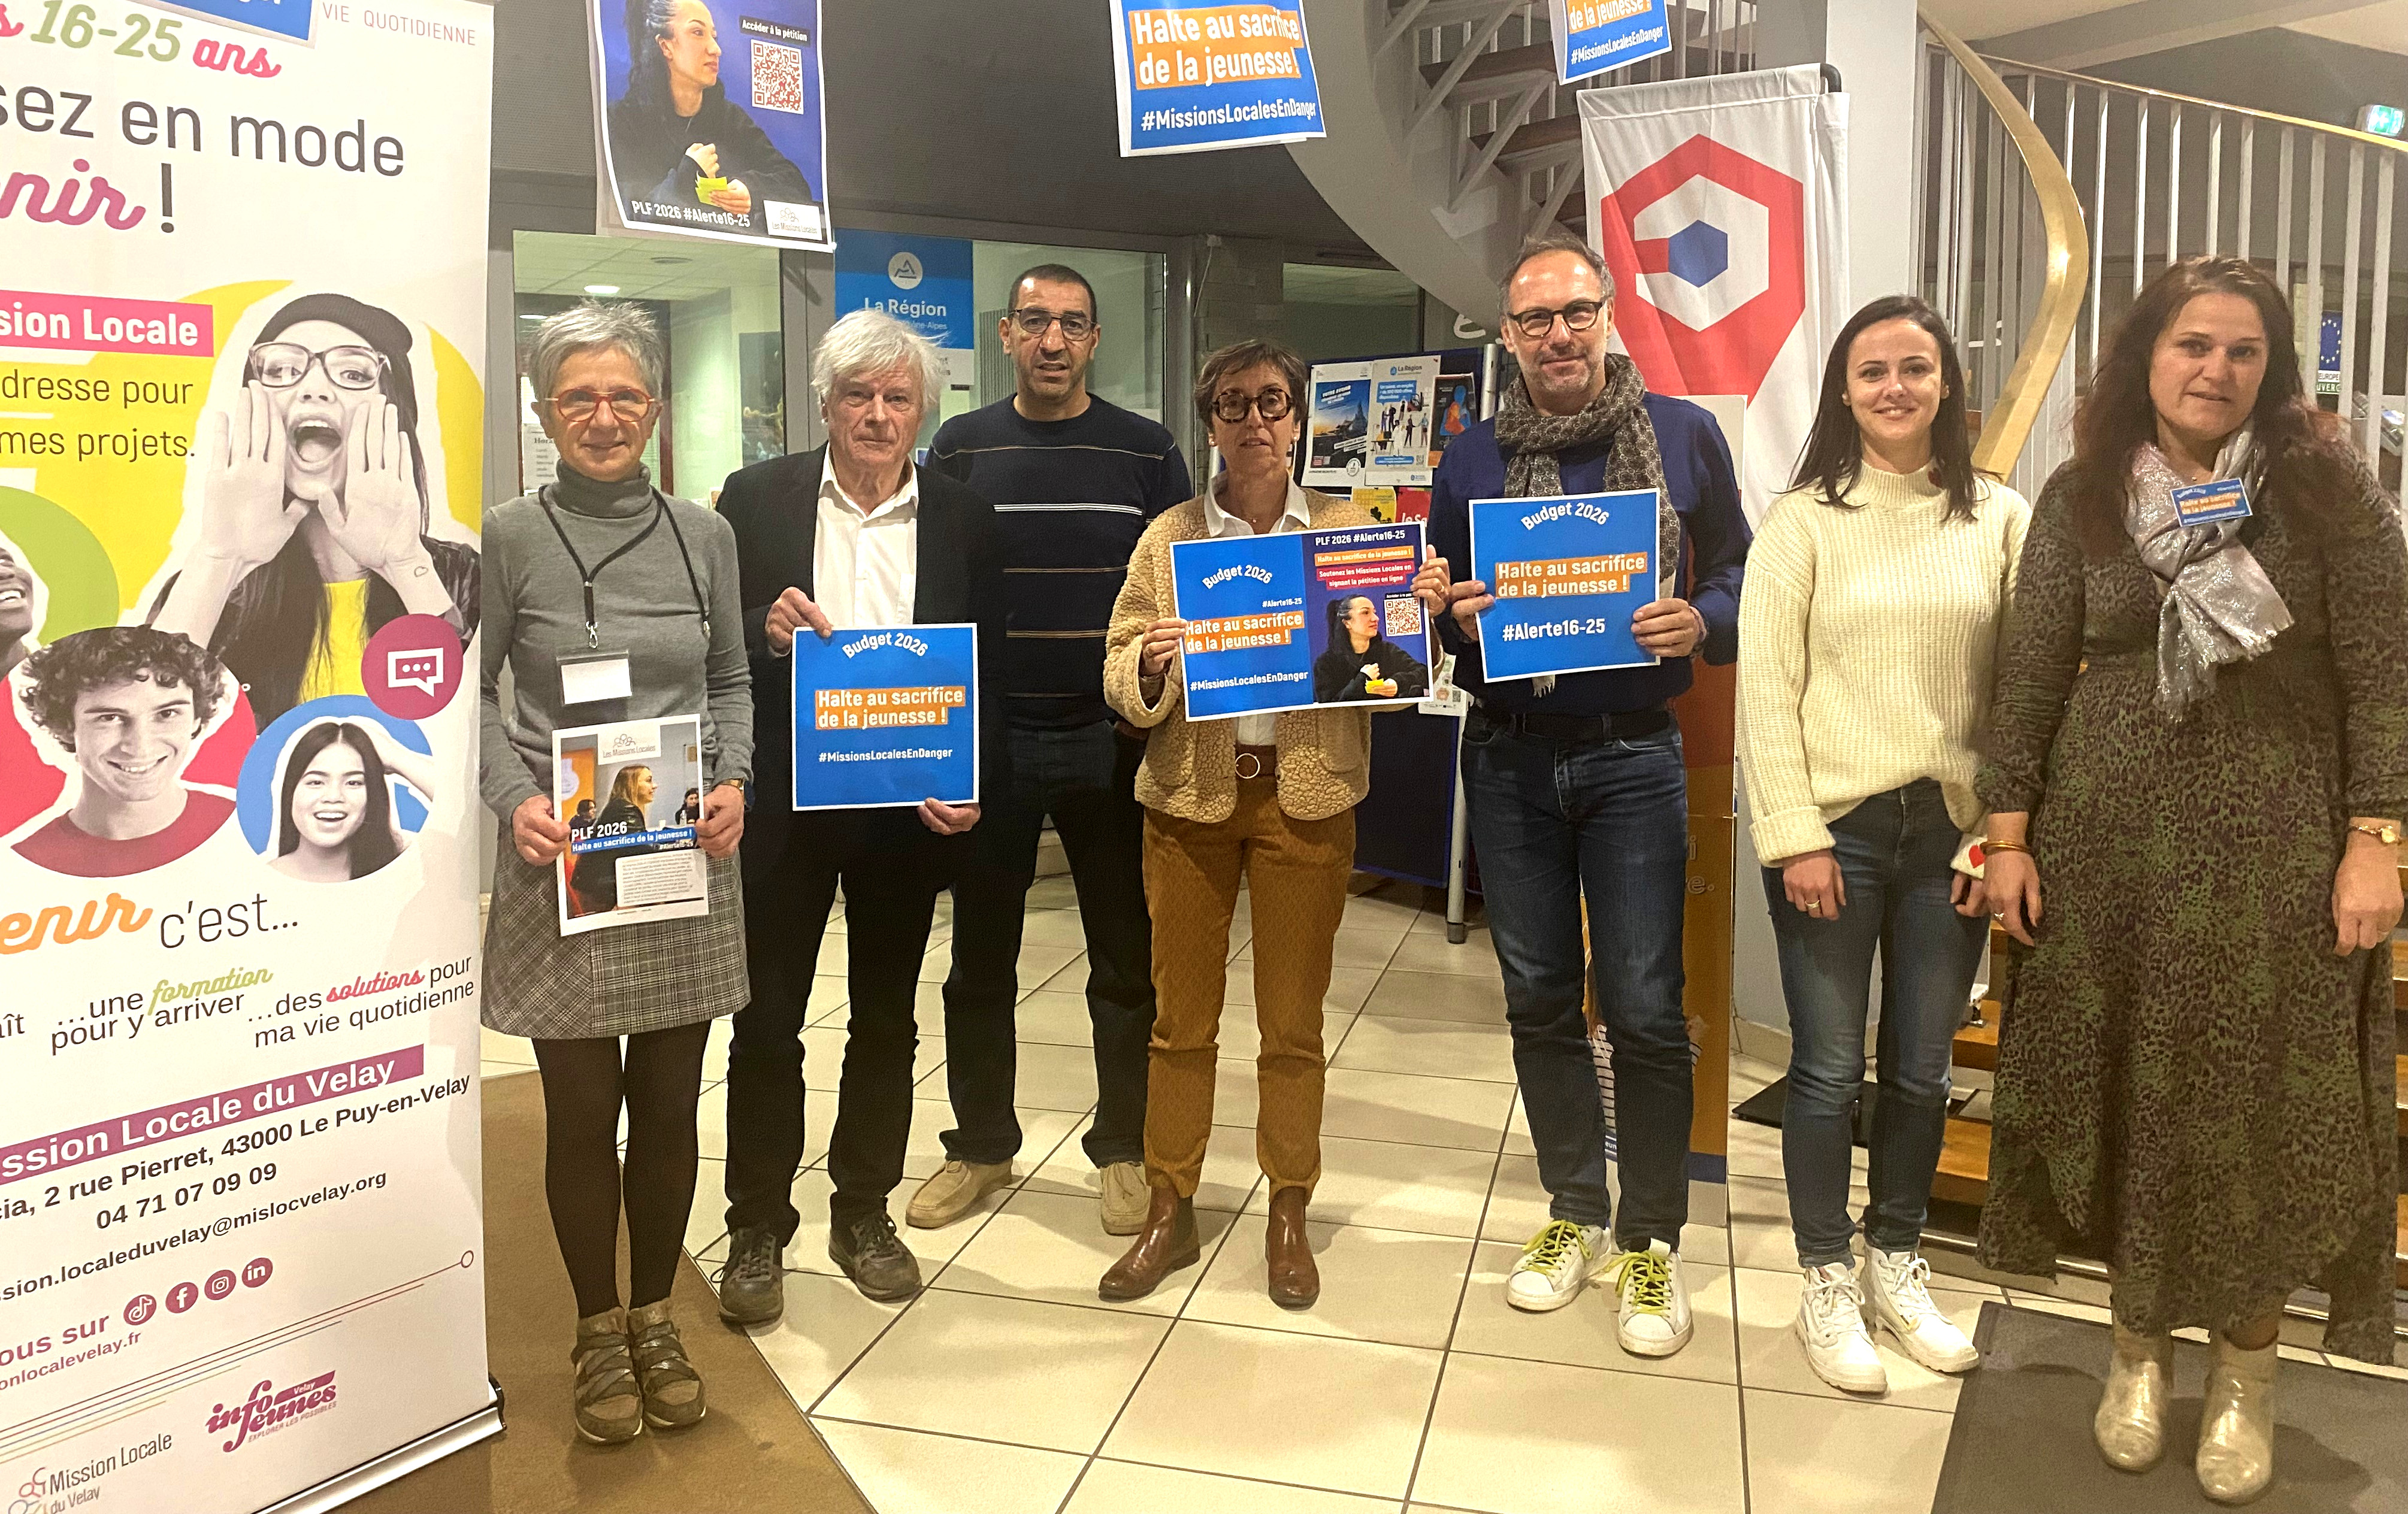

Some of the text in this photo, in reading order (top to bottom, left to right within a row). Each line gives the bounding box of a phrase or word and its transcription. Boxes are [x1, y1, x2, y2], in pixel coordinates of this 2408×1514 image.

[323, 2, 477, 46] VIE QUOTIDIENNE
[742, 19, 807, 42] Accéder à la pétition
[1133, 7, 1300, 45] Halte au sacrifice
[1569, 0, 1644, 31] de la jeunesse
[31, 0, 183, 62] 16-25
[192, 38, 282, 78] ans
[1571, 26, 1664, 65] #MissionsLocalesEnDanger
[1139, 46, 1292, 87] de la jeunesse
[1141, 98, 1317, 132] #MissionsLocalesEnDanger
[0, 85, 404, 177] ez en mode
[160, 163, 175, 234] !
[631, 200, 751, 228] PLF 2026 #Alerte16-25
[888, 298, 947, 319] Région
[83, 308, 198, 347] Locale
[1, 368, 194, 409] dresse pour
[0, 428, 196, 463] mes projets.
[1520, 502, 1610, 531] Budget 2026
[1315, 529, 1405, 546] PLF 2026 #Alerte16-25
[1341, 552, 1367, 561] sacrifice
[1381, 549, 1408, 559] jeunesse
[1498, 554, 1645, 579] Halte au sacrifice
[1202, 564, 1273, 589] Budget 2026
[1319, 570, 1346, 578] Soutenez
[1356, 565, 1381, 575] Missions
[1381, 564, 1403, 573] Locales
[1329, 579, 1350, 588] signant
[1357, 576, 1381, 586] pétition
[1388, 574, 1403, 583] ligne
[1498, 574, 1627, 598] de la jeunesse !
[1262, 597, 1303, 608] #Alerte16-25
[1185, 612, 1303, 636] Halte au sacrifice
[1502, 618, 1606, 642] #Alerte16-25
[841, 632, 929, 659] Budget 2026
[1187, 629, 1290, 653] de la jeunesse !
[1190, 671, 1309, 692] #MissionsLocalesEnDanger
[818, 687, 963, 708] Halte au sacrifice
[818, 706, 946, 730] de la jeunesse !
[818, 747, 953, 762] #MissionsLocalesEnDanger
[571, 820, 628, 841] PLF 2026
[572, 842, 592, 852] Halte
[603, 837, 636, 847] sacrifice
[636, 834, 646, 843] de
[655, 831, 688, 842] jeunesse
[160, 893, 298, 949] c'est...
[147, 966, 274, 1016] formation
[326, 969, 426, 1003] solutions
[429, 956, 473, 989] pour
[51, 993, 244, 1056] pour y arriver
[255, 980, 474, 1048] ma vie quotidienne
[2, 1059, 395, 1178] ssion Locale du Velay
[0, 1074, 471, 1219] ia, 2 rue Pierret, 43000 Le Puy-en-Velay
[96, 1162, 277, 1230] 04 71 07 09 09
[0, 1171, 387, 1301] sion.localeduvelay@mislocvelay.org
[0, 1315, 110, 1366] ous sur
[0, 1331, 142, 1391] onlocalevelay.fr
[294, 1380, 316, 1396] Velay
[247, 1400, 338, 1443] EXPLORER LES POSSIBLES
[49, 1433, 173, 1495] Mission Locale
[50, 1486, 101, 1514] du Velay
